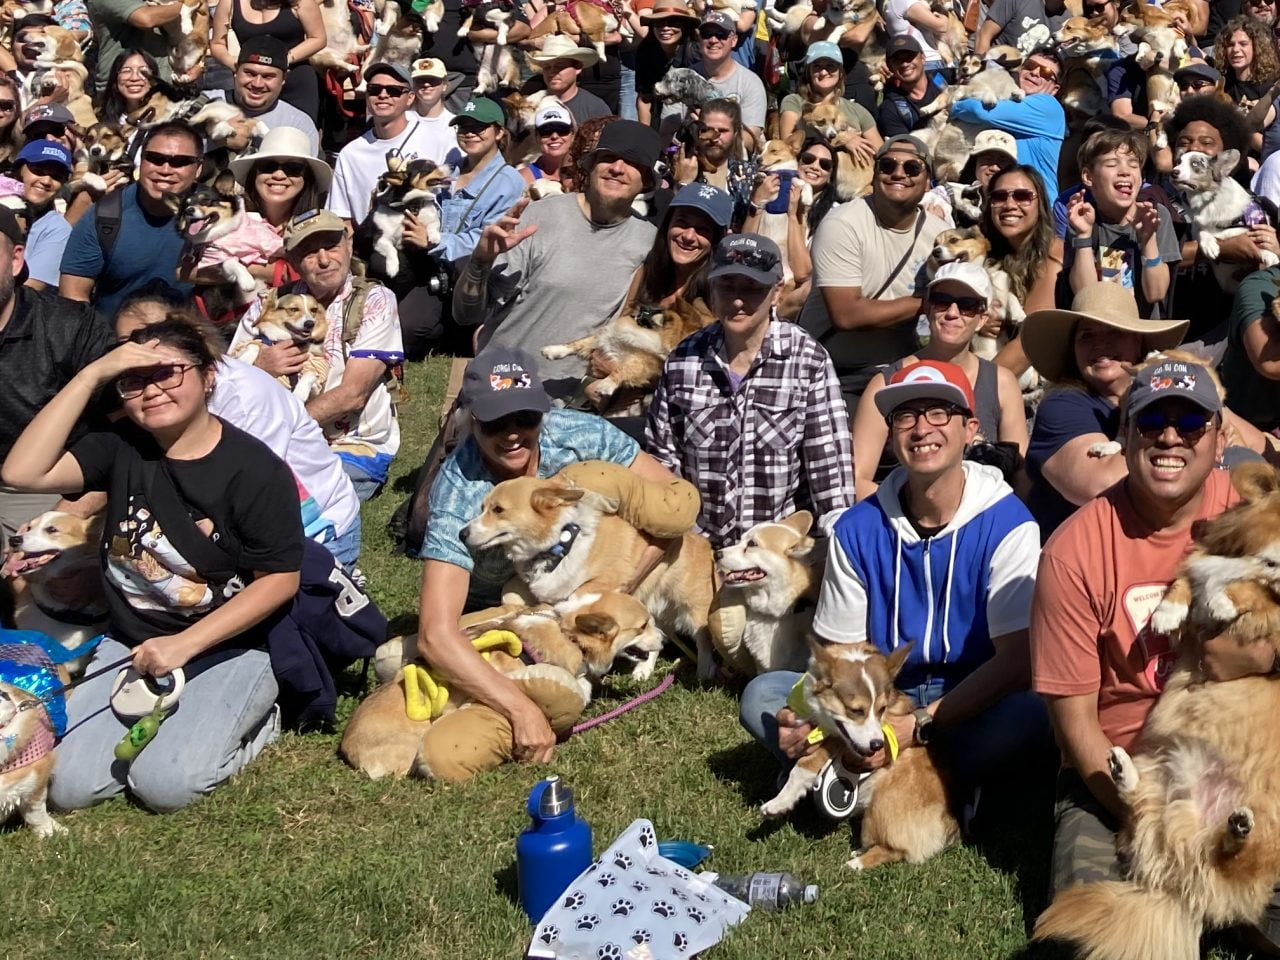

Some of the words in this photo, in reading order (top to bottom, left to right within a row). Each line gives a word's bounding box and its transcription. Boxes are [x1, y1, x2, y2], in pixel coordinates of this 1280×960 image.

[493, 364, 511, 373] CORGI
[1154, 363, 1172, 375] COGI
[1173, 363, 1188, 373] CON
